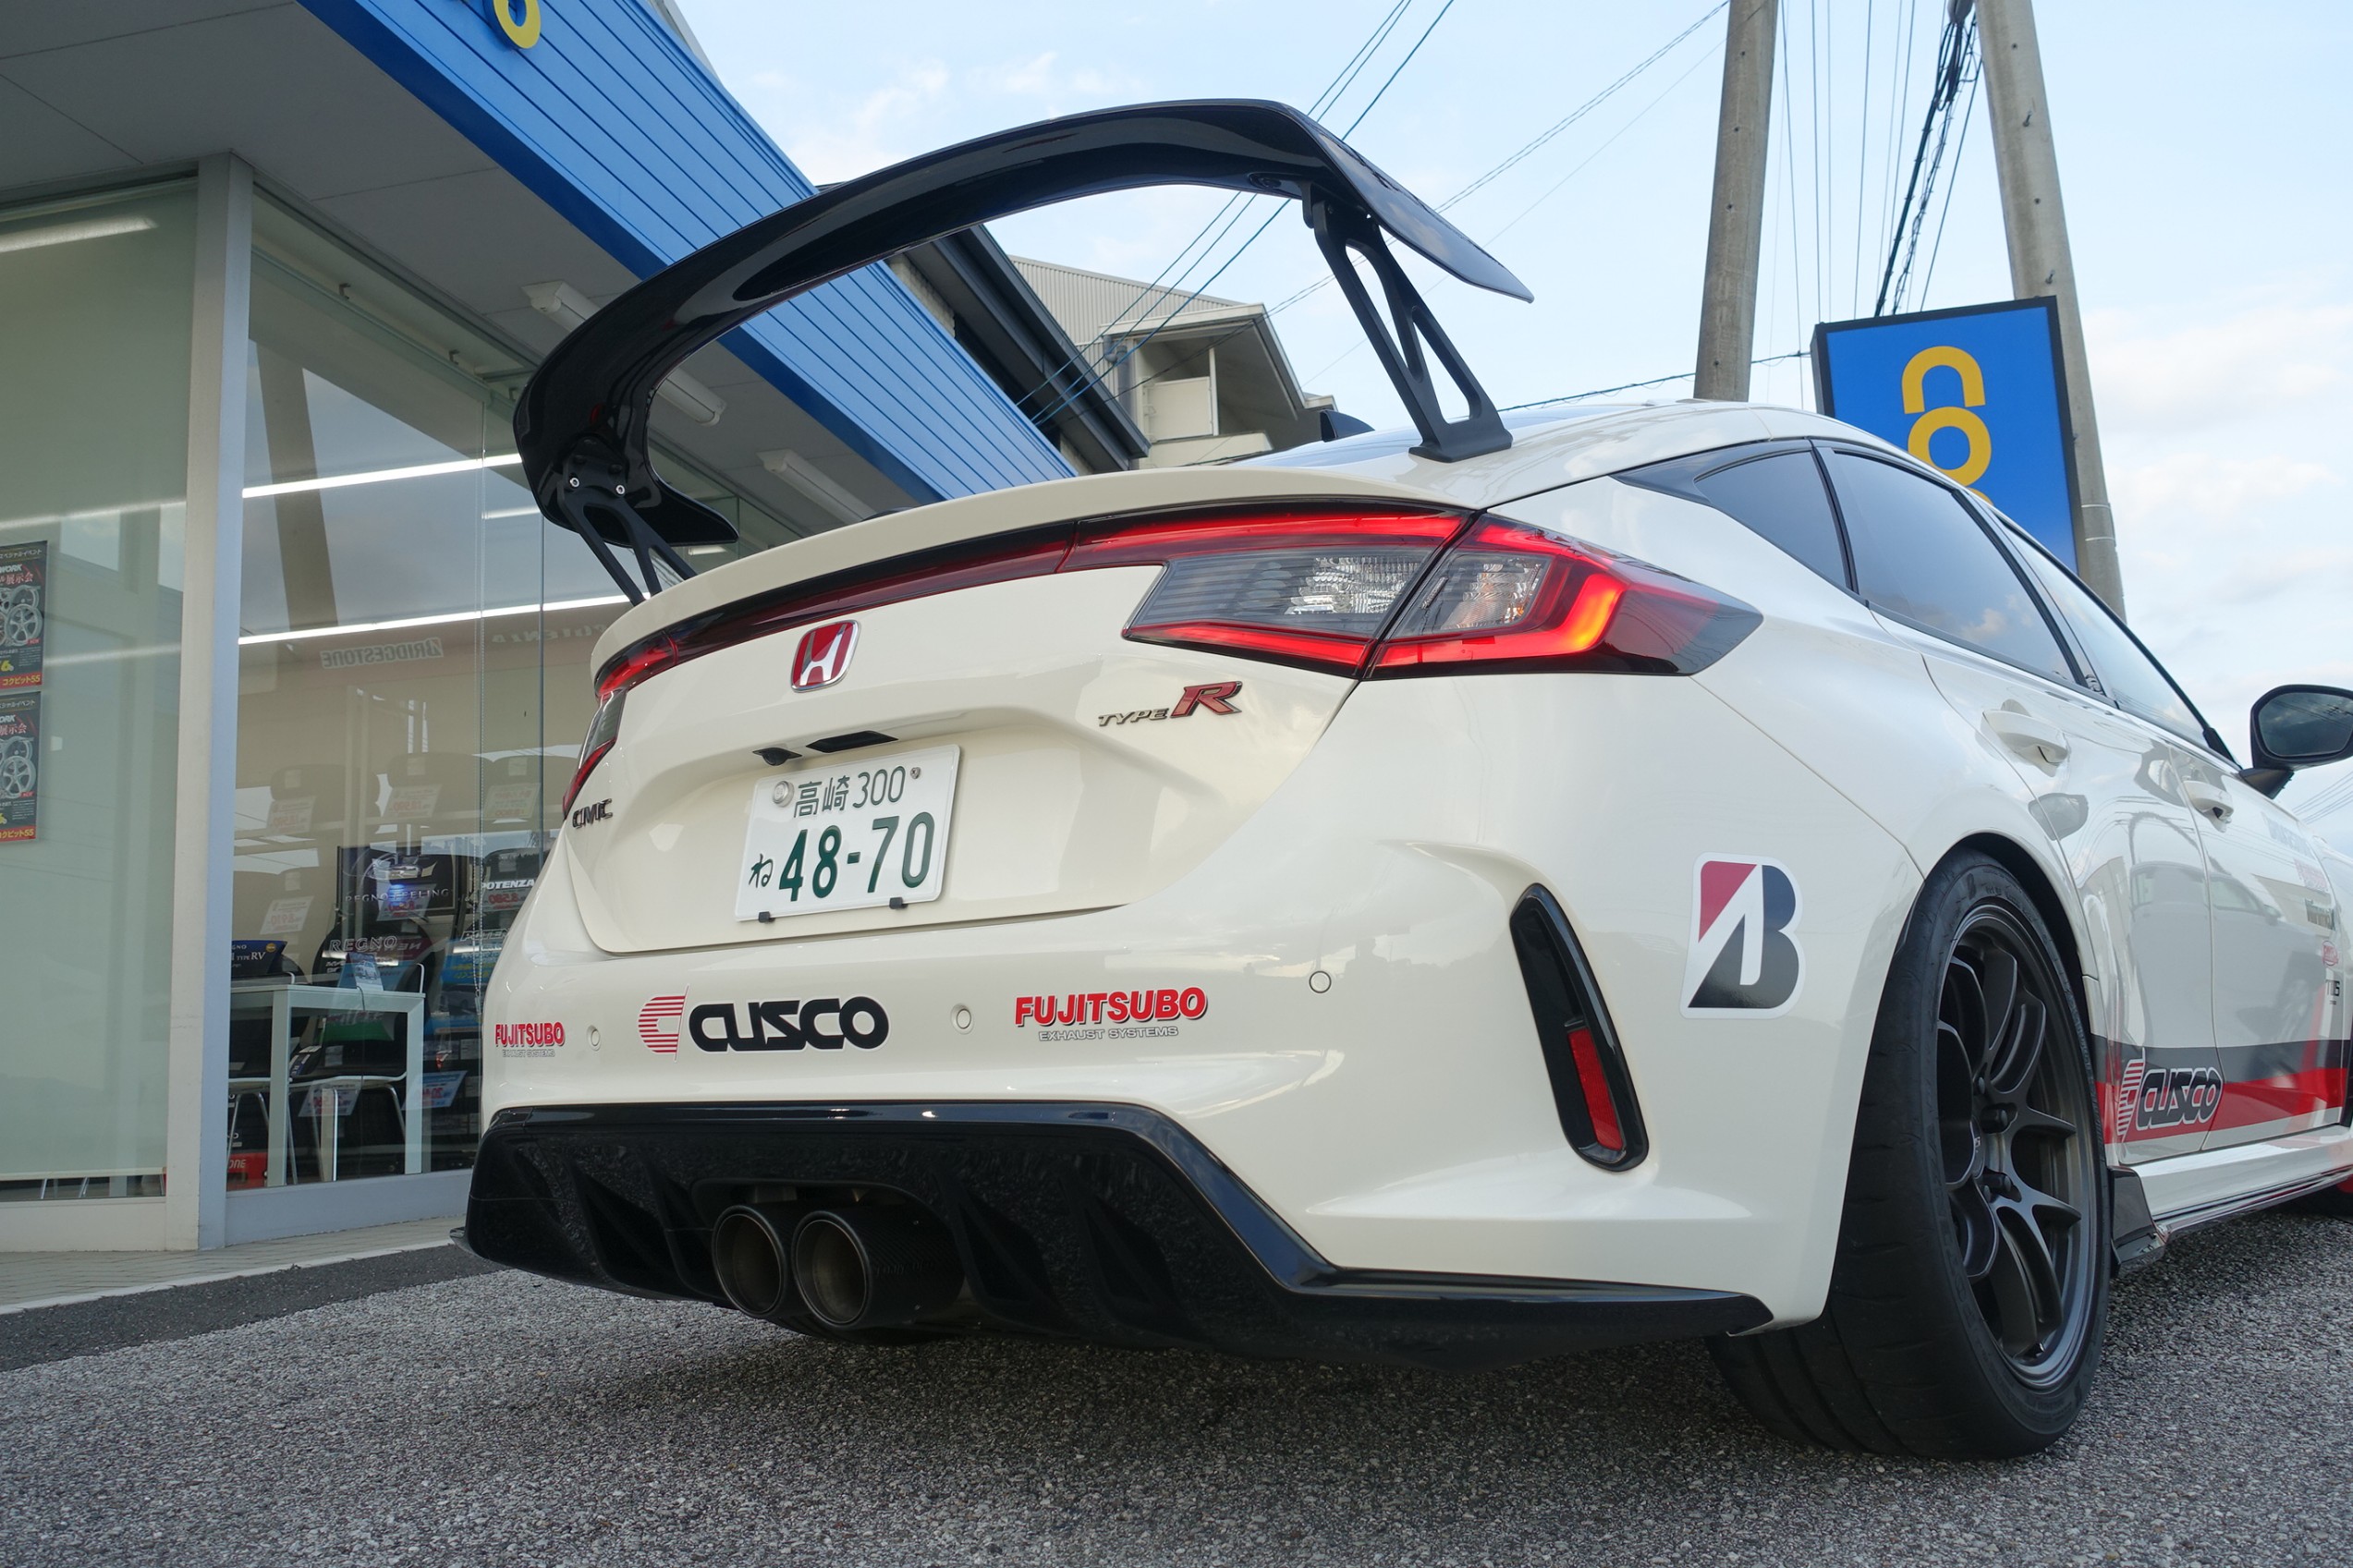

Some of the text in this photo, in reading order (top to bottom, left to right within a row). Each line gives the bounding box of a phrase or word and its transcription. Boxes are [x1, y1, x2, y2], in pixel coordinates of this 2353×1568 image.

[1098, 681, 1243, 726] TYPE R
[794, 765, 907, 818] 高崎 300
[748, 811, 935, 902] ね 48-70
[345, 892, 389, 903] REGNO
[482, 879, 535, 890] POTENZA
[250, 952, 266, 961] RV
[329, 935, 397, 953] REGNO
[689, 995, 890, 1051] CUSCO
[1014, 986, 1209, 1027] FUJITSUBO
[494, 1021, 566, 1048] FUJITSUBO
[1038, 1026, 1179, 1042] EXHAUST SYSTEMS
[2136, 1067, 2224, 1131] CUSCO
